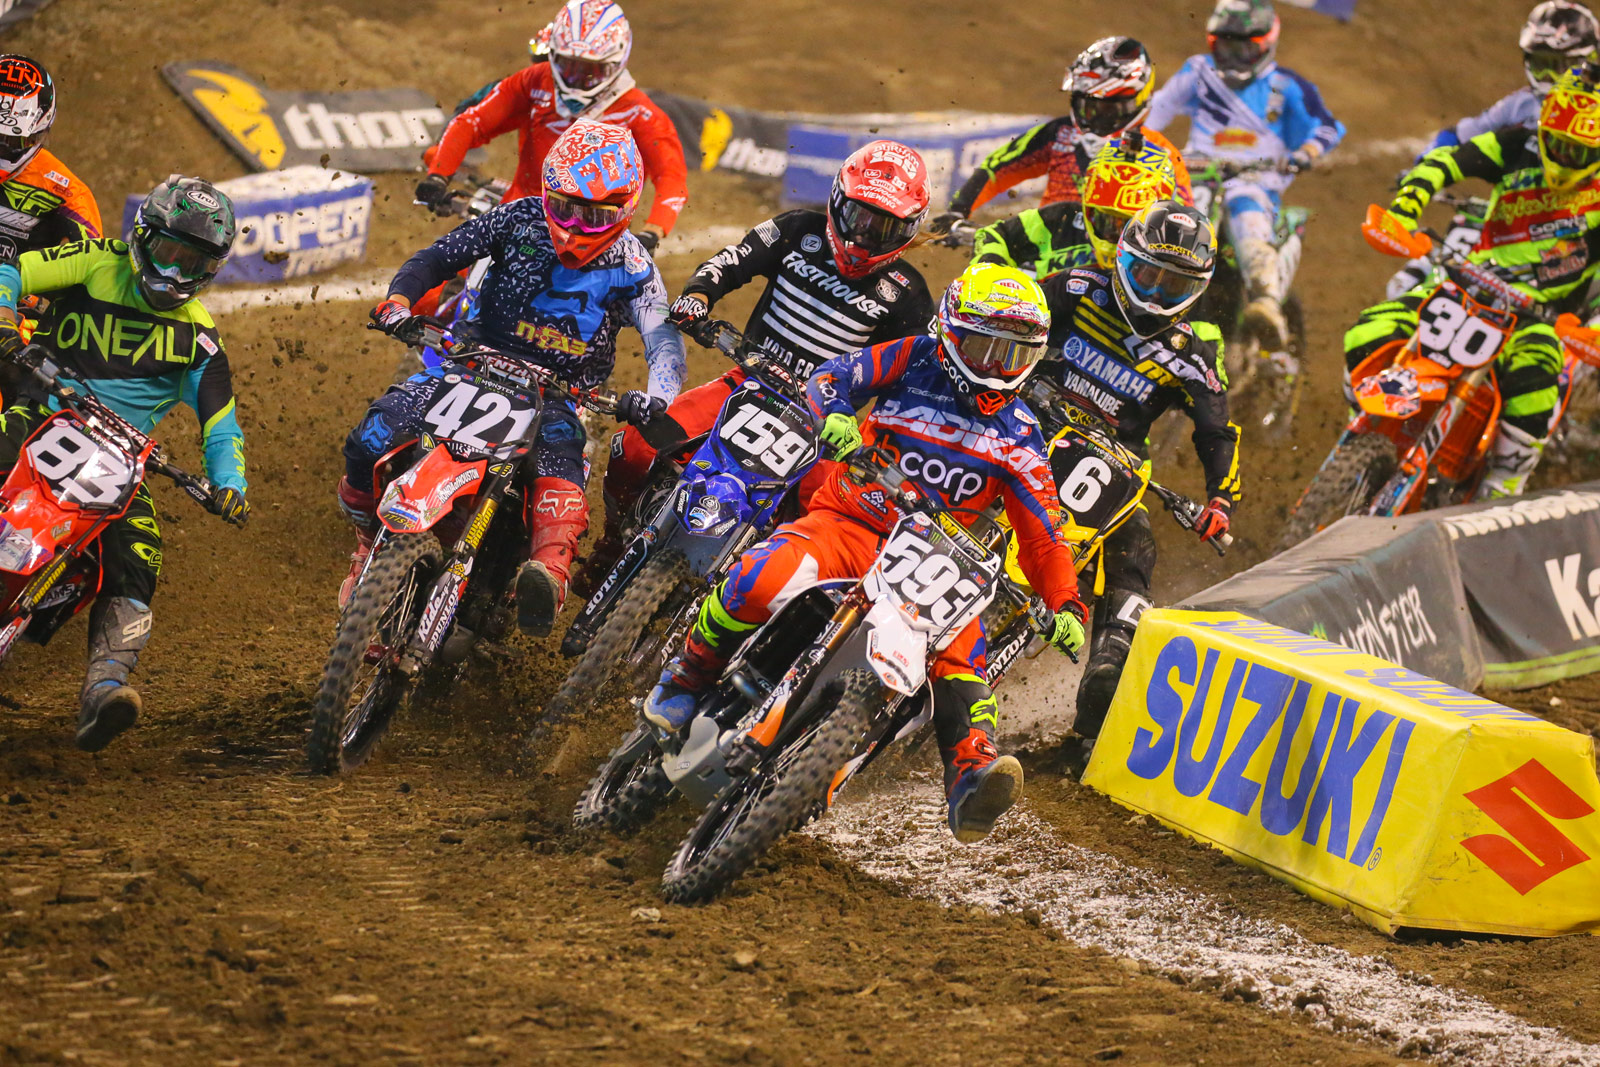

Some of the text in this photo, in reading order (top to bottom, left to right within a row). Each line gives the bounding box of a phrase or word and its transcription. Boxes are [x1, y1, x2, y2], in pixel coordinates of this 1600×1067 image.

[283, 103, 445, 149] thor
[187, 191, 217, 208] Arai
[1172, 214, 1192, 225] BELL
[781, 250, 890, 320] FASTHOUSE
[1000, 281, 1021, 291] BELL
[1418, 296, 1503, 369] 30
[480, 379, 515, 396] MONSTER
[1063, 371, 1125, 417] YAMALUBE
[1080, 345, 1154, 403] YAMAHA
[424, 381, 536, 451] 421
[718, 402, 811, 478] 159
[772, 400, 804, 424] MONSTER
[26, 427, 132, 503] 83
[900, 451, 983, 502] corp
[1059, 456, 1112, 513] 6
[903, 521, 930, 537] AMA
[879, 530, 983, 628] 593
[432, 583, 460, 644] DUNLOP
[1339, 584, 1437, 667] MONSTER
[1126, 635, 1416, 867] SUZUKI
